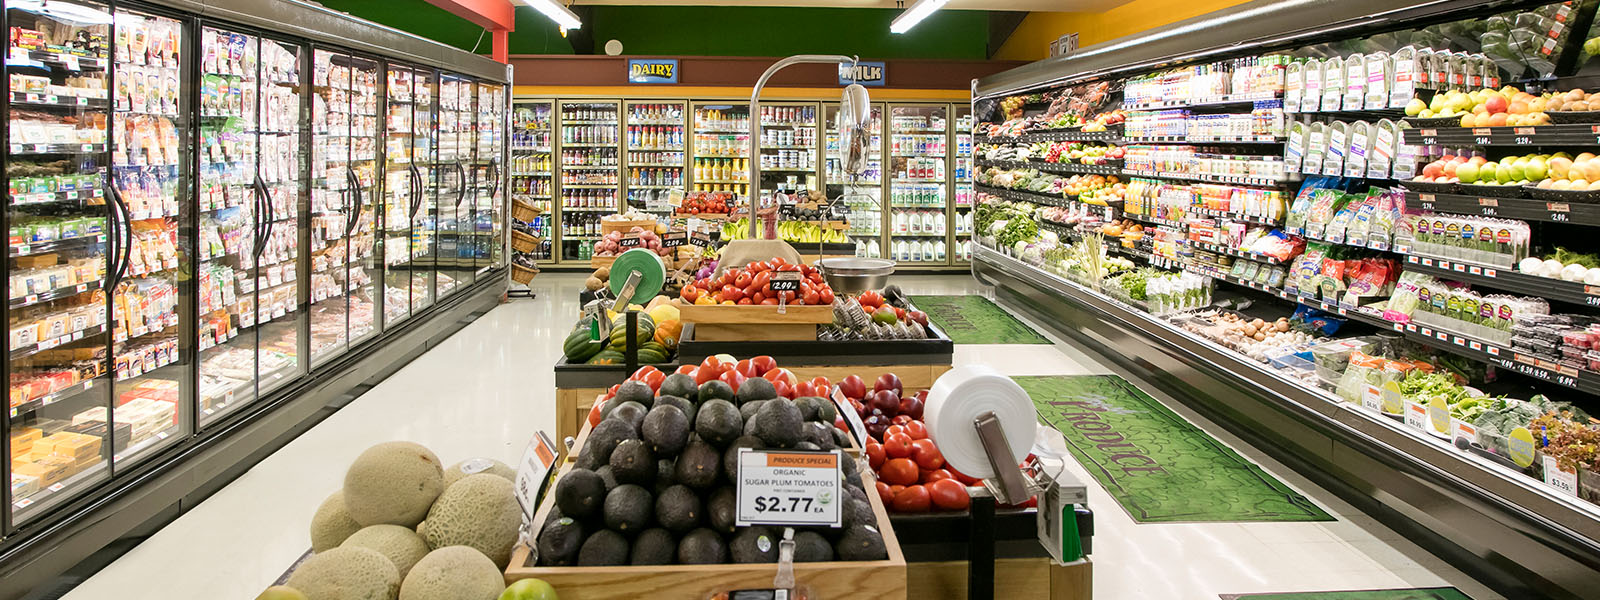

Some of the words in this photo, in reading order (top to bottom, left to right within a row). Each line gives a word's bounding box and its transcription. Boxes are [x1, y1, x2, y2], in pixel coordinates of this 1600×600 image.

[632, 64, 673, 77] DAIRY
[841, 65, 881, 80] MILK
[1048, 401, 1170, 477] PRODUCE
[754, 496, 814, 514] $2.77
